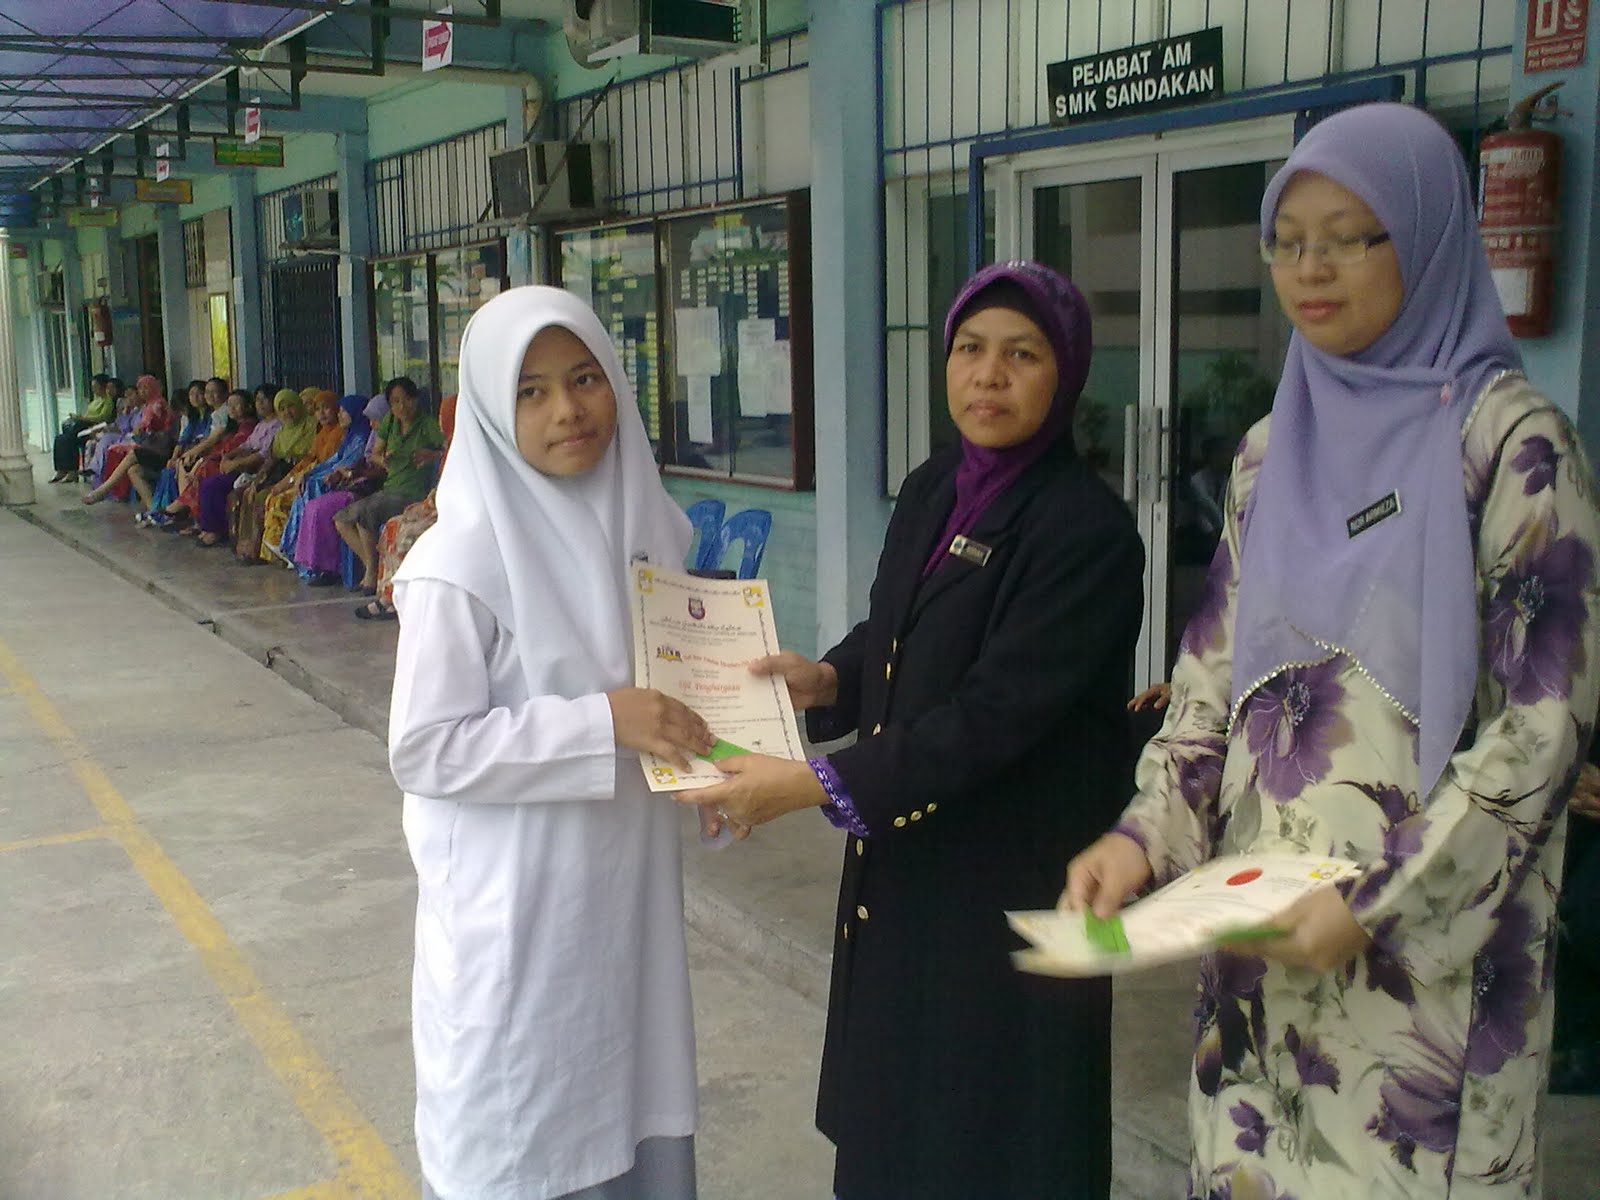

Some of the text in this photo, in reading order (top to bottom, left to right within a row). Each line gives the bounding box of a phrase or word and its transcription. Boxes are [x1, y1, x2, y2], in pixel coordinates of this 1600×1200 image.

[1072, 41, 1192, 88] PEJABAT AM
[1055, 66, 1215, 118] SMK SANDAKAN
